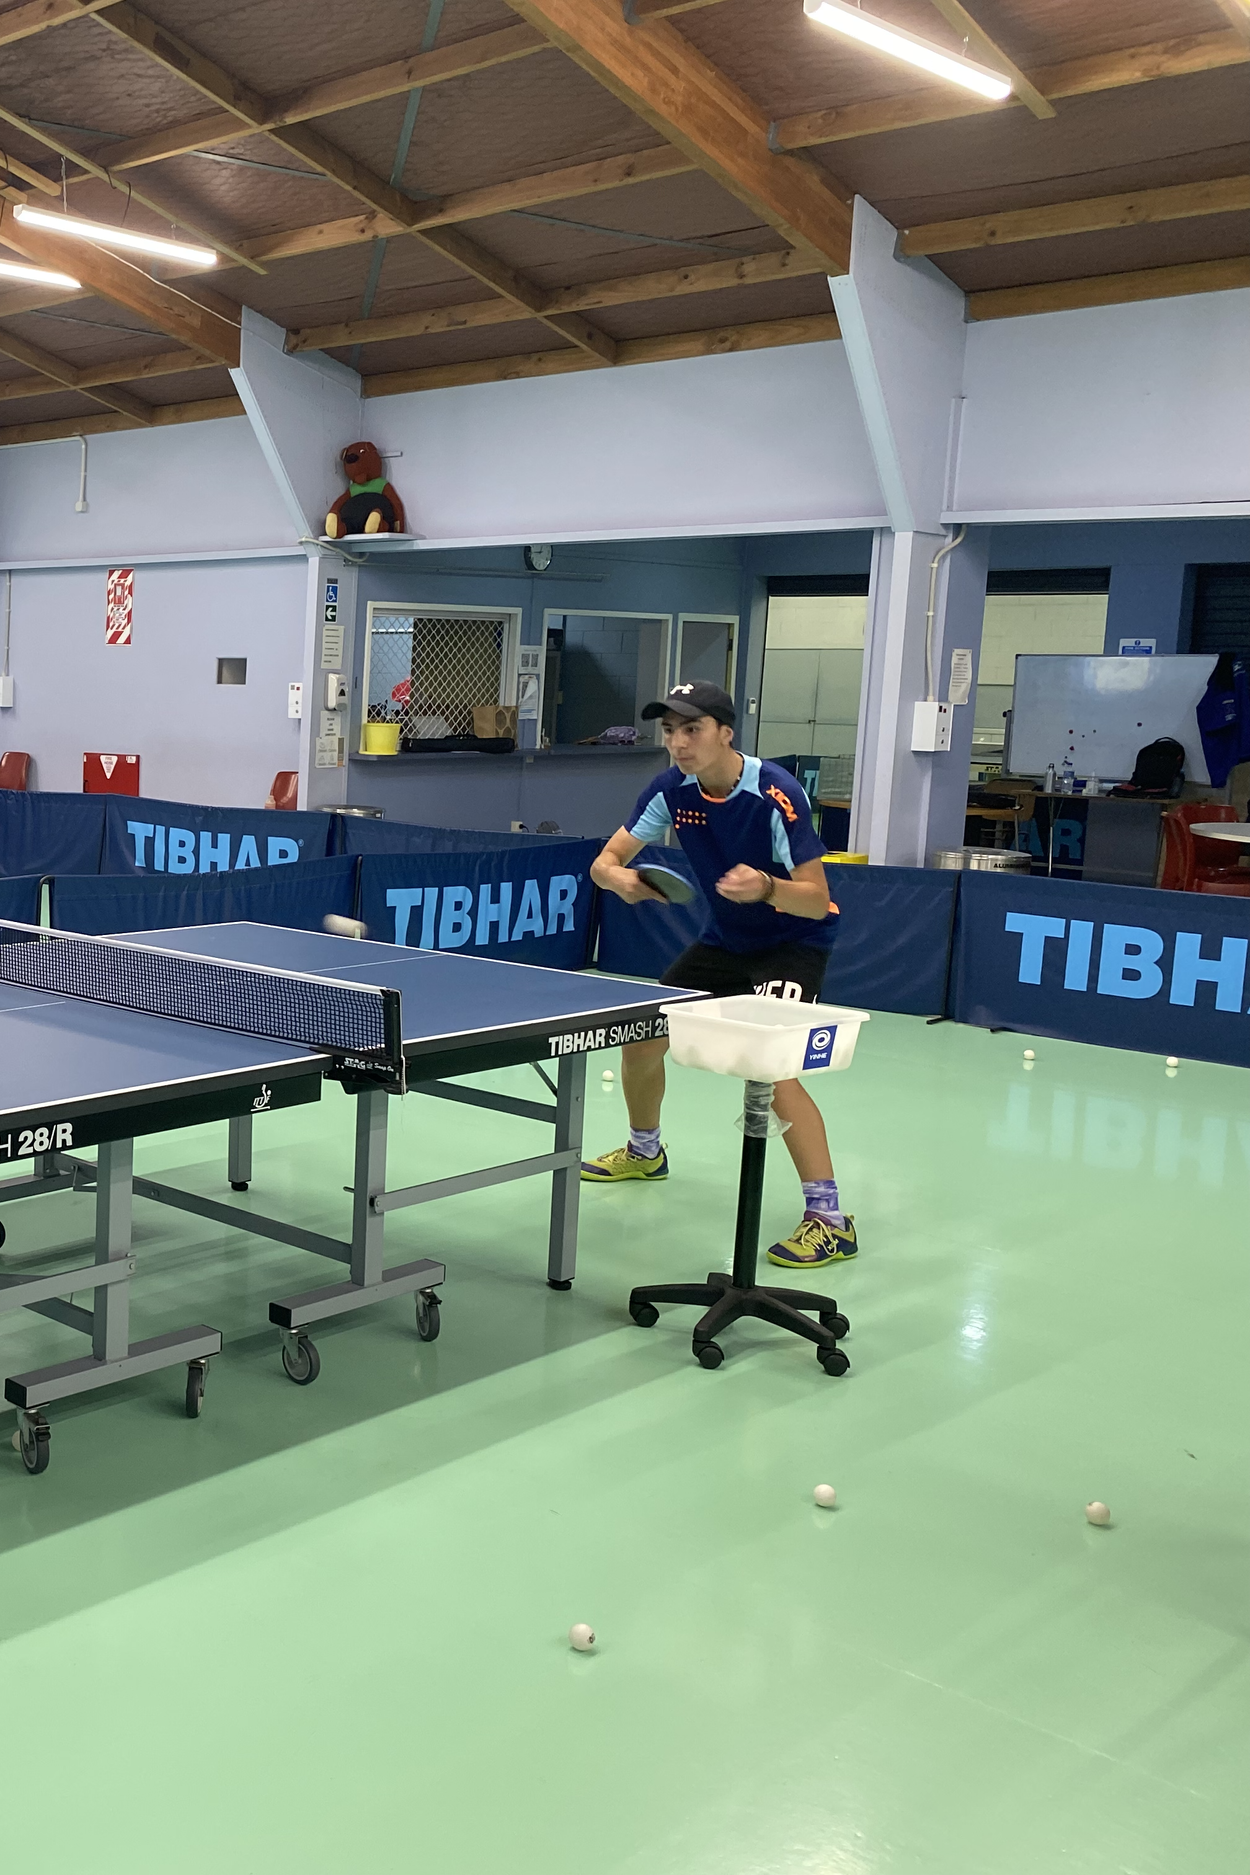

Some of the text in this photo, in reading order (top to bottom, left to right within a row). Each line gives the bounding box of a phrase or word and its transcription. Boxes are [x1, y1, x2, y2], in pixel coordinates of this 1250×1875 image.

[386, 874, 579, 950] TIBHAR
[1005, 912, 1250, 1013] TIBH
[549, 1028, 606, 1056] TIBHAR
[609, 1020, 652, 1045] SMASH
[17, 1122, 73, 1156] 28/R
